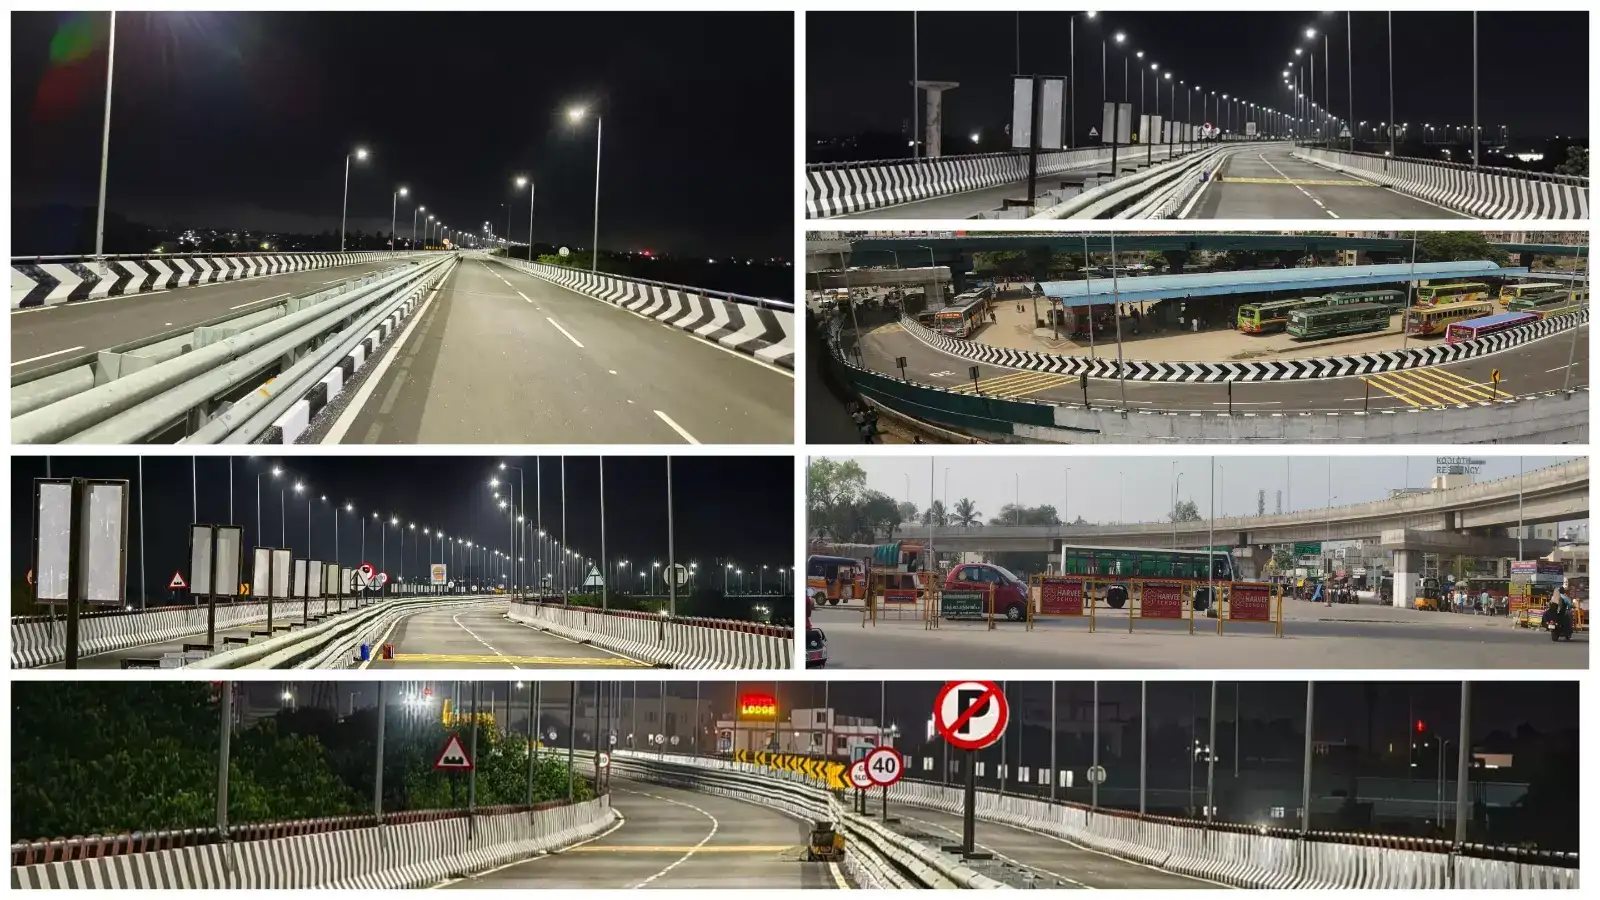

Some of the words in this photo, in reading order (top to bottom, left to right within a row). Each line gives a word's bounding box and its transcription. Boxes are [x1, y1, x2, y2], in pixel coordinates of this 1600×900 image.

[1056, 589, 1081, 597] HARVEE
[742, 705, 776, 715] LODGE
[957, 689, 991, 734] P
[872, 757, 896, 773] 40
